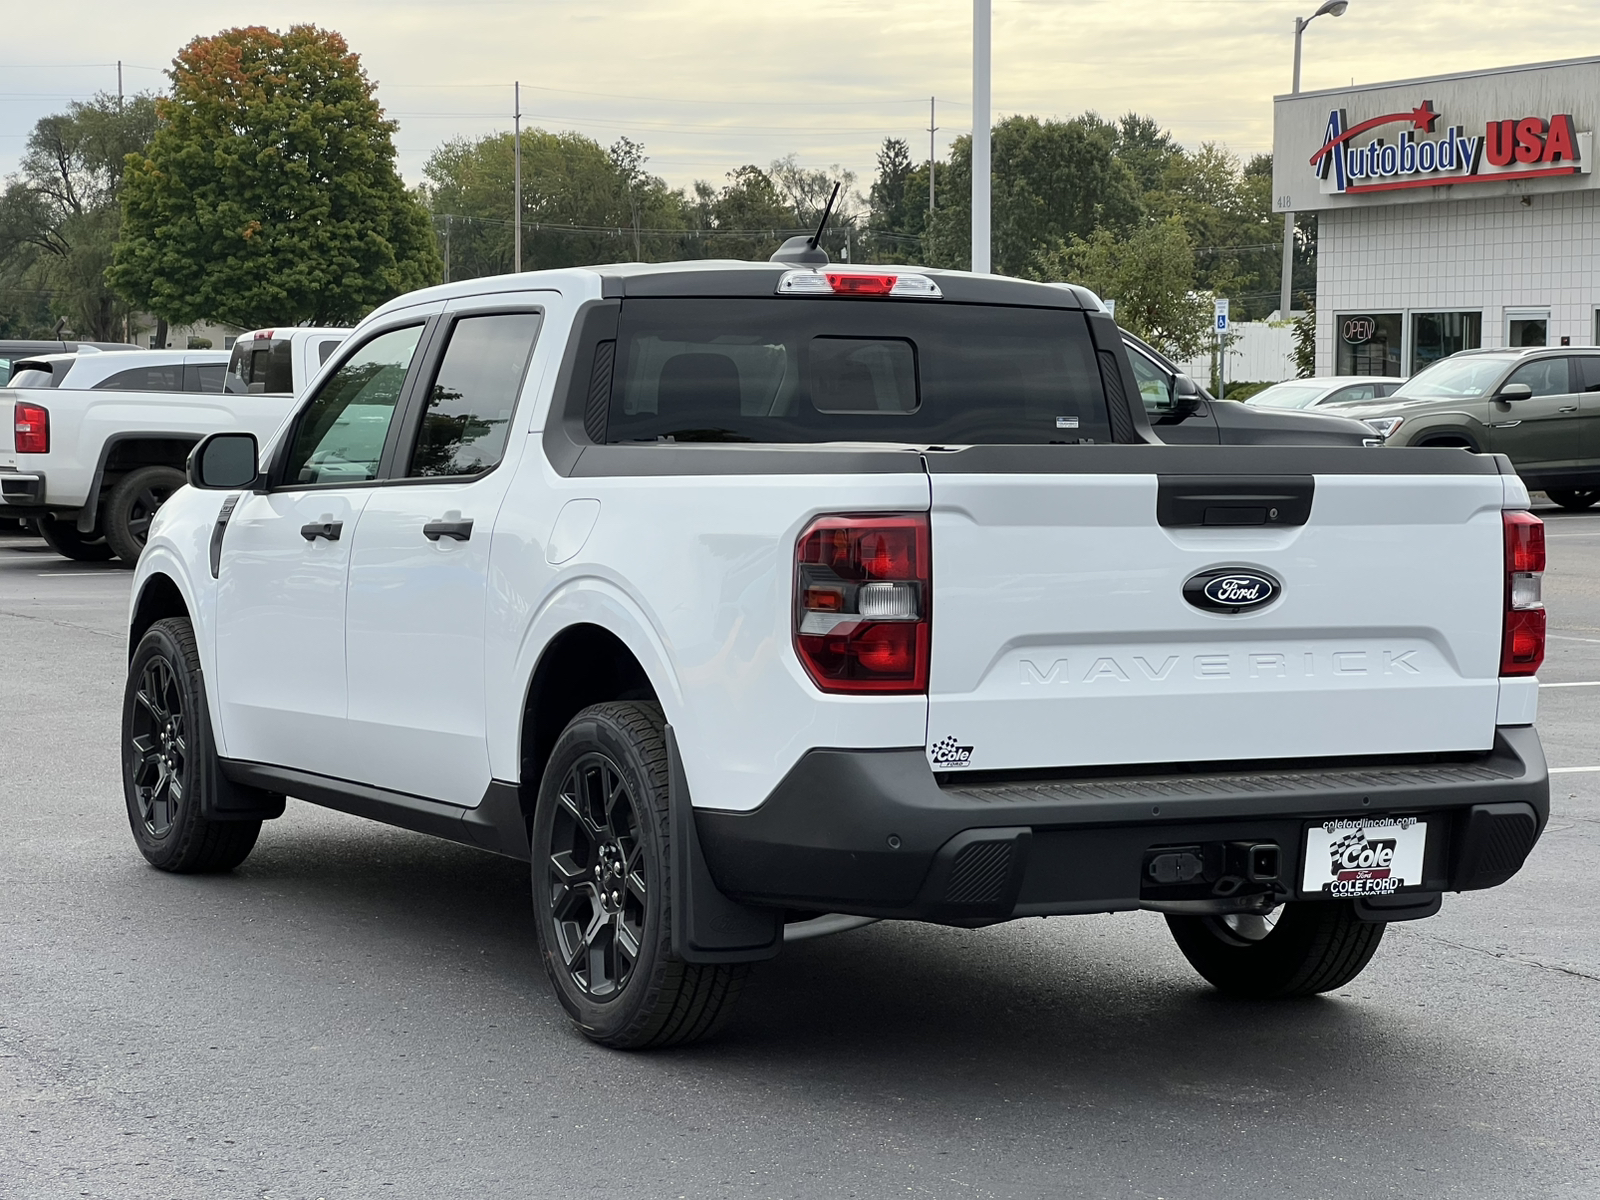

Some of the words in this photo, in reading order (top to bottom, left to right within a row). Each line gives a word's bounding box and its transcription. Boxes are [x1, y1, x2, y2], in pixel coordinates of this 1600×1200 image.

[1315, 108, 1480, 193] Autobody
[1485, 113, 1575, 167] USA
[1276, 195, 1292, 208] 418
[1343, 320, 1373, 339] OPEN
[1217, 578, 1260, 601] Ford
[1019, 650, 1421, 685] MAVERICK
[937, 748, 970, 761] Cole
[1322, 816, 1418, 830] colefordlincoln.com
[1341, 843, 1394, 868] Cole
[1355, 870, 1373, 879] Ford
[1330, 880, 1364, 893] COLE
[1365, 878, 1399, 891] FORD
[1332, 889, 1395, 898] COLDWATER
